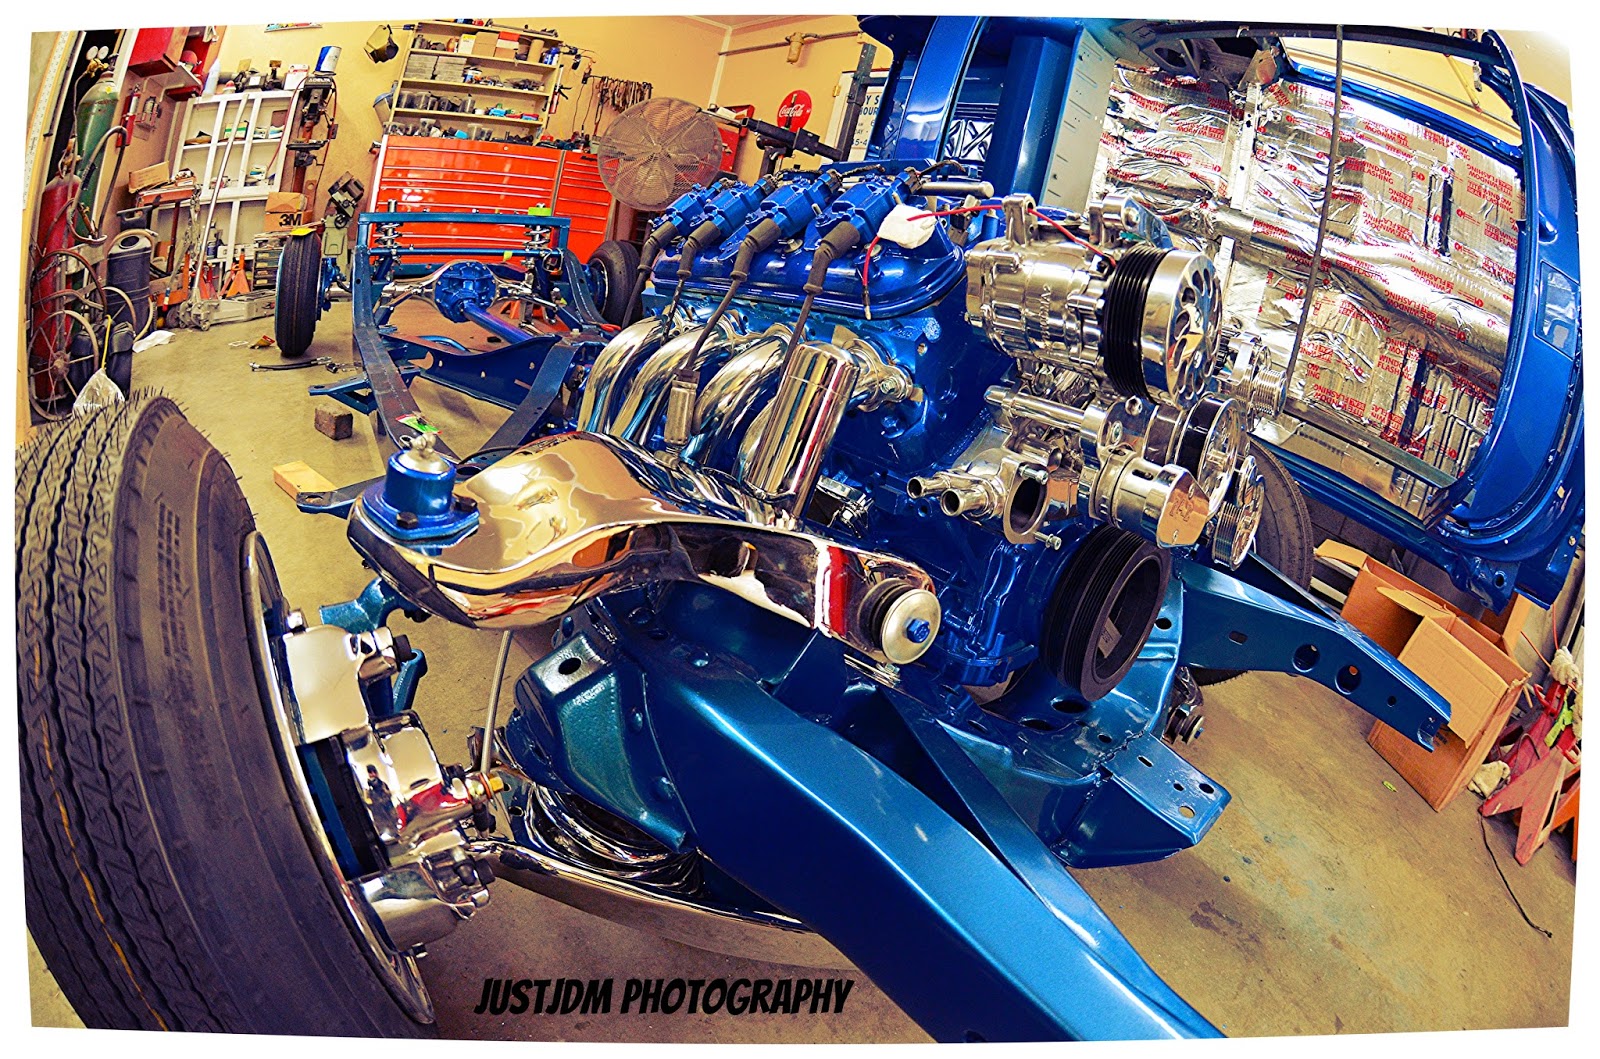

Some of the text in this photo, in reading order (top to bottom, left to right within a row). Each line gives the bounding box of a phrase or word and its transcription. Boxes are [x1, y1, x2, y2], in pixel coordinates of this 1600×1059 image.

[1361, 159, 1392, 177] WINDOW
[1362, 166, 1394, 185] FLASHING
[1467, 163, 1499, 187] FLASHING
[279, 213, 302, 227] 3M
[1410, 265, 1446, 287] FLASHING
[1384, 289, 1424, 311] FLASHING
[1313, 383, 1351, 406] FLASHING
